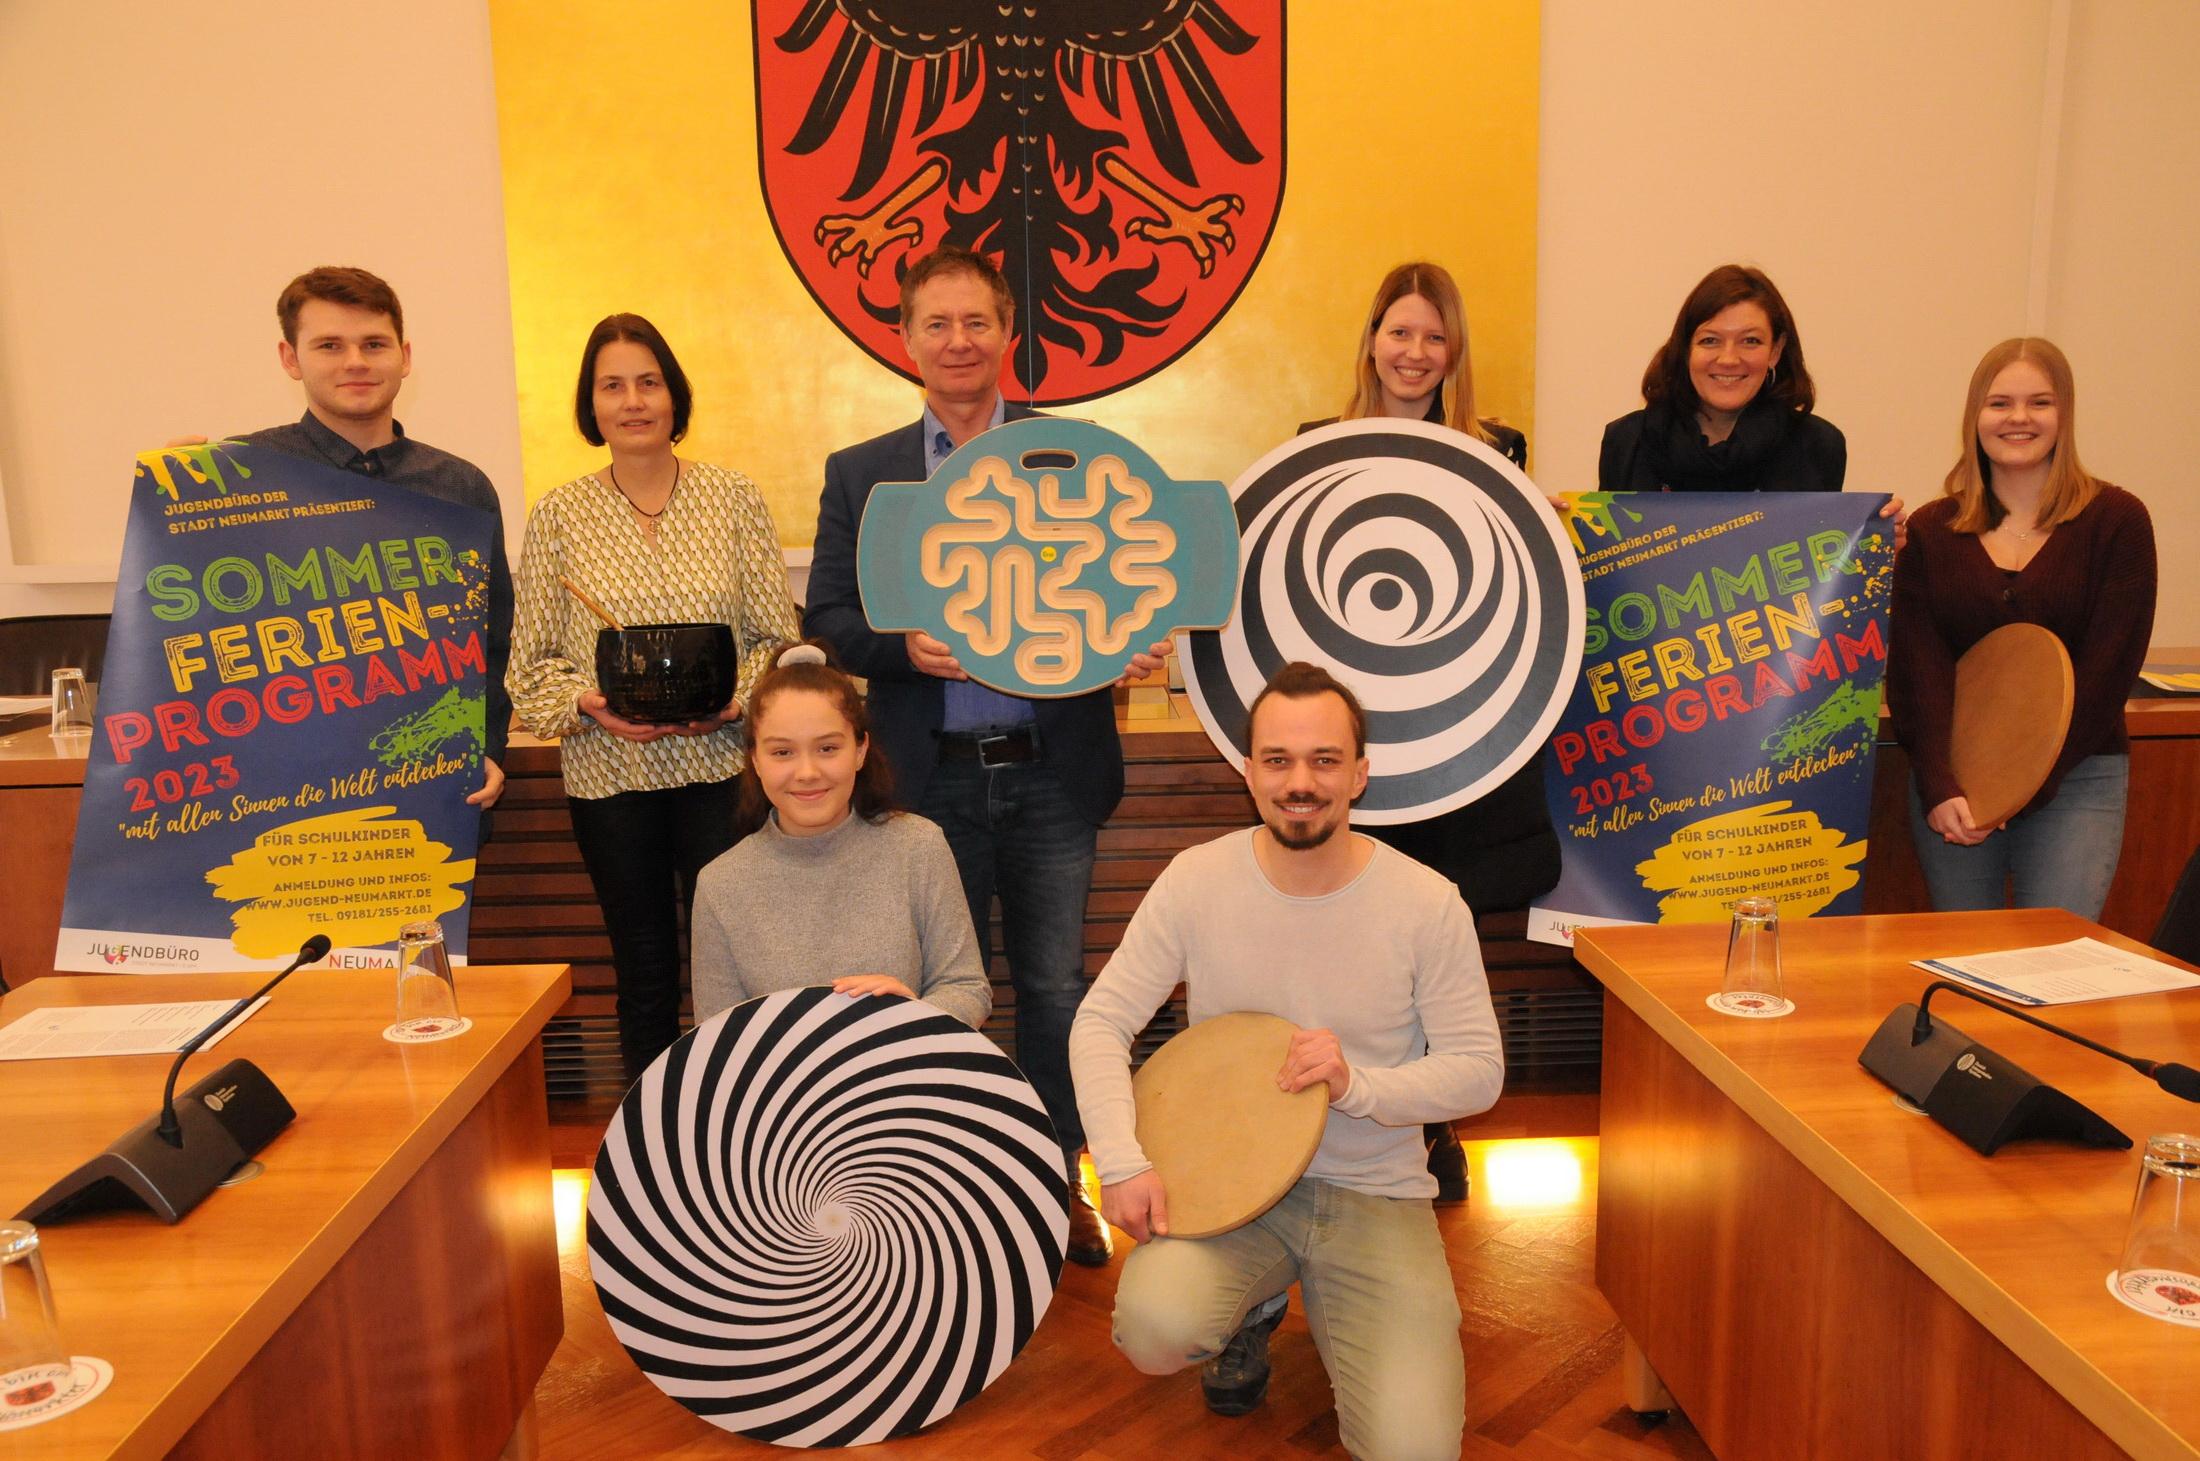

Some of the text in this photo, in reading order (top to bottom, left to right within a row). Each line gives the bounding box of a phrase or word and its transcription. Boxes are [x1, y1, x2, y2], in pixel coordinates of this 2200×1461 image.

[164, 490, 289, 516] JUGENDBÜRO DER
[169, 499, 376, 535] STADT NEUMARKT PRÄSENTIERT:
[1654, 525, 1677, 540] DER
[1582, 511, 1764, 582] STADT NEUMARKT PRÄSENTIERT:
[145, 535, 479, 622] SOMMER-
[163, 591, 449, 693] FERIEN-
[1585, 592, 1844, 713] FERIEN-
[103, 631, 488, 764] PROGRAMM
[1552, 619, 1886, 776] PROGRAMM
[124, 754, 240, 812] 2023
[1569, 743, 1858, 839] "mit allen Sinnen die Welt entdecken"
[1570, 764, 1654, 815] 2023
[118, 753, 468, 841] "mit allen Sinnen die Welt entdecken"
[262, 827, 411, 847] FÜR SCHULKINDER
[1677, 819, 1807, 844] FÜR SCHULKINDER
[268, 853, 304, 867] VON
[308, 852, 318, 866] 7
[331, 849, 349, 864] 12
[352, 847, 415, 863] JAHREN
[1682, 850, 1713, 862] VON
[1716, 847, 1724, 859] 7
[1738, 845, 1753, 857] 12
[1756, 837, 1813, 855] JAHREN
[273, 873, 431, 893] ANMELDUNG UND INFOS:
[1689, 858, 1829, 884] ANMELDUNG UND INFOS:
[1668, 872, 1830, 900] WWW.JUGEND-NEUMARKT.DE
[1721, 886, 1831, 911] TE 1/255-2681
[245, 888, 432, 912] WWW.JUGEND-NEUMARKT.DE
[307, 905, 432, 924] TEL. 09181/255-2681
[87, 943, 200, 962] JUGENDBÜRO
[329, 954, 395, 969] NEUMA
